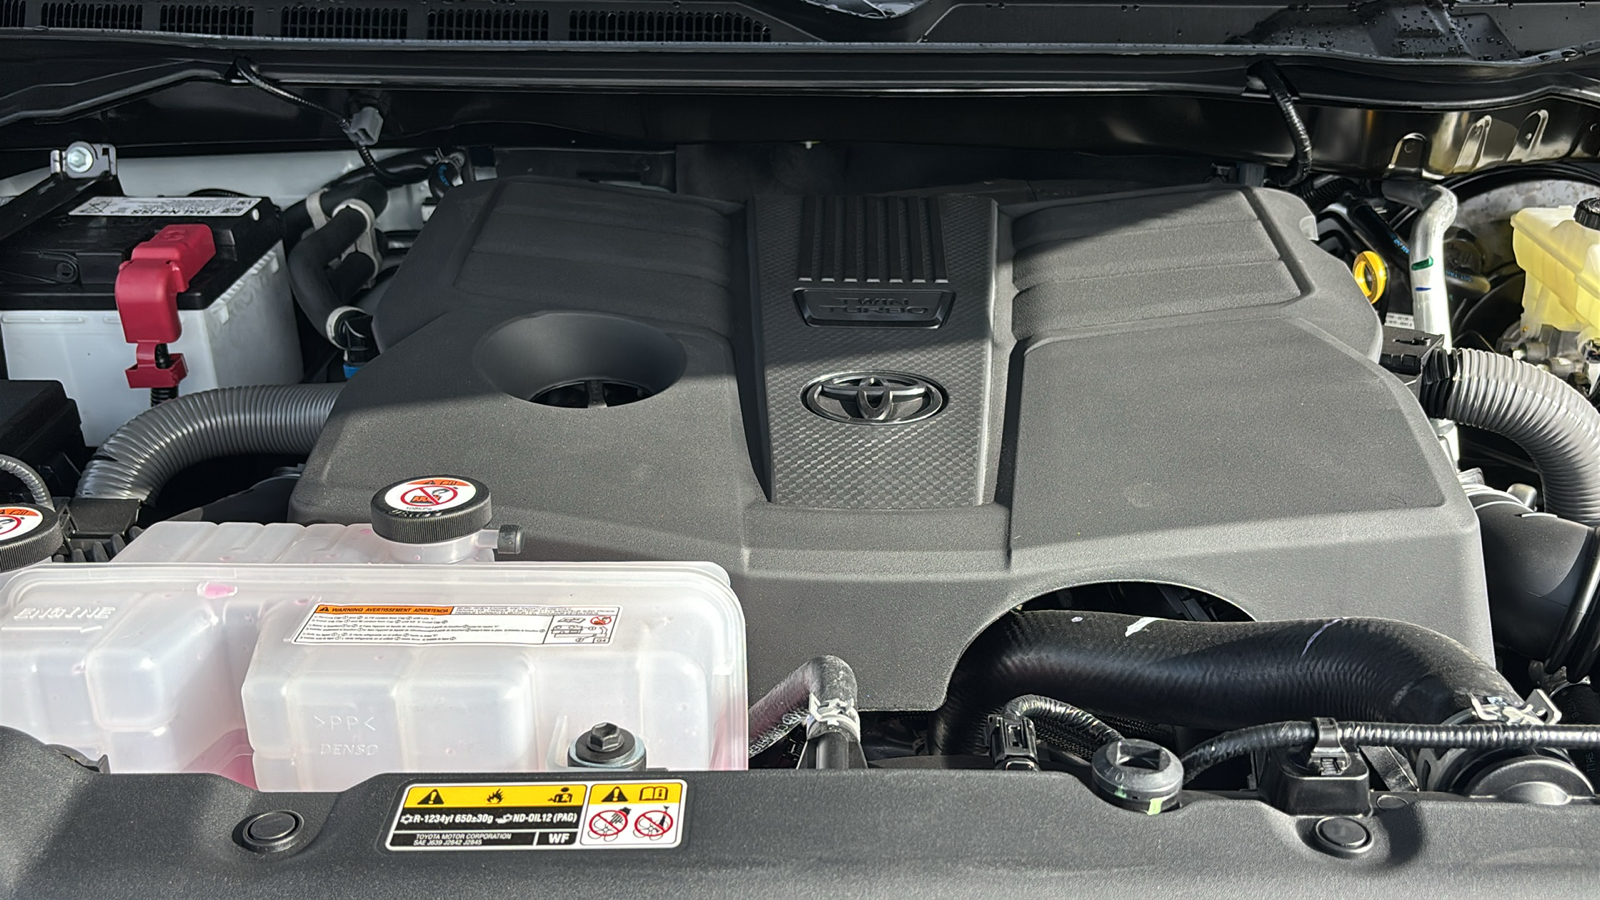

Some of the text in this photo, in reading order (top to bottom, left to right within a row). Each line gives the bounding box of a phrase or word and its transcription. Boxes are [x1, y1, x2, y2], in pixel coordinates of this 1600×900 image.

[834, 297, 909, 306] TWIN
[819, 305, 928, 314] TURBO
[13, 606, 116, 619] ENGINE
[320, 743, 379, 756] DENSO
[455, 814, 493, 824] 650±30g
[553, 812, 578, 823] (PAG)
[548, 833, 570, 844] WF
